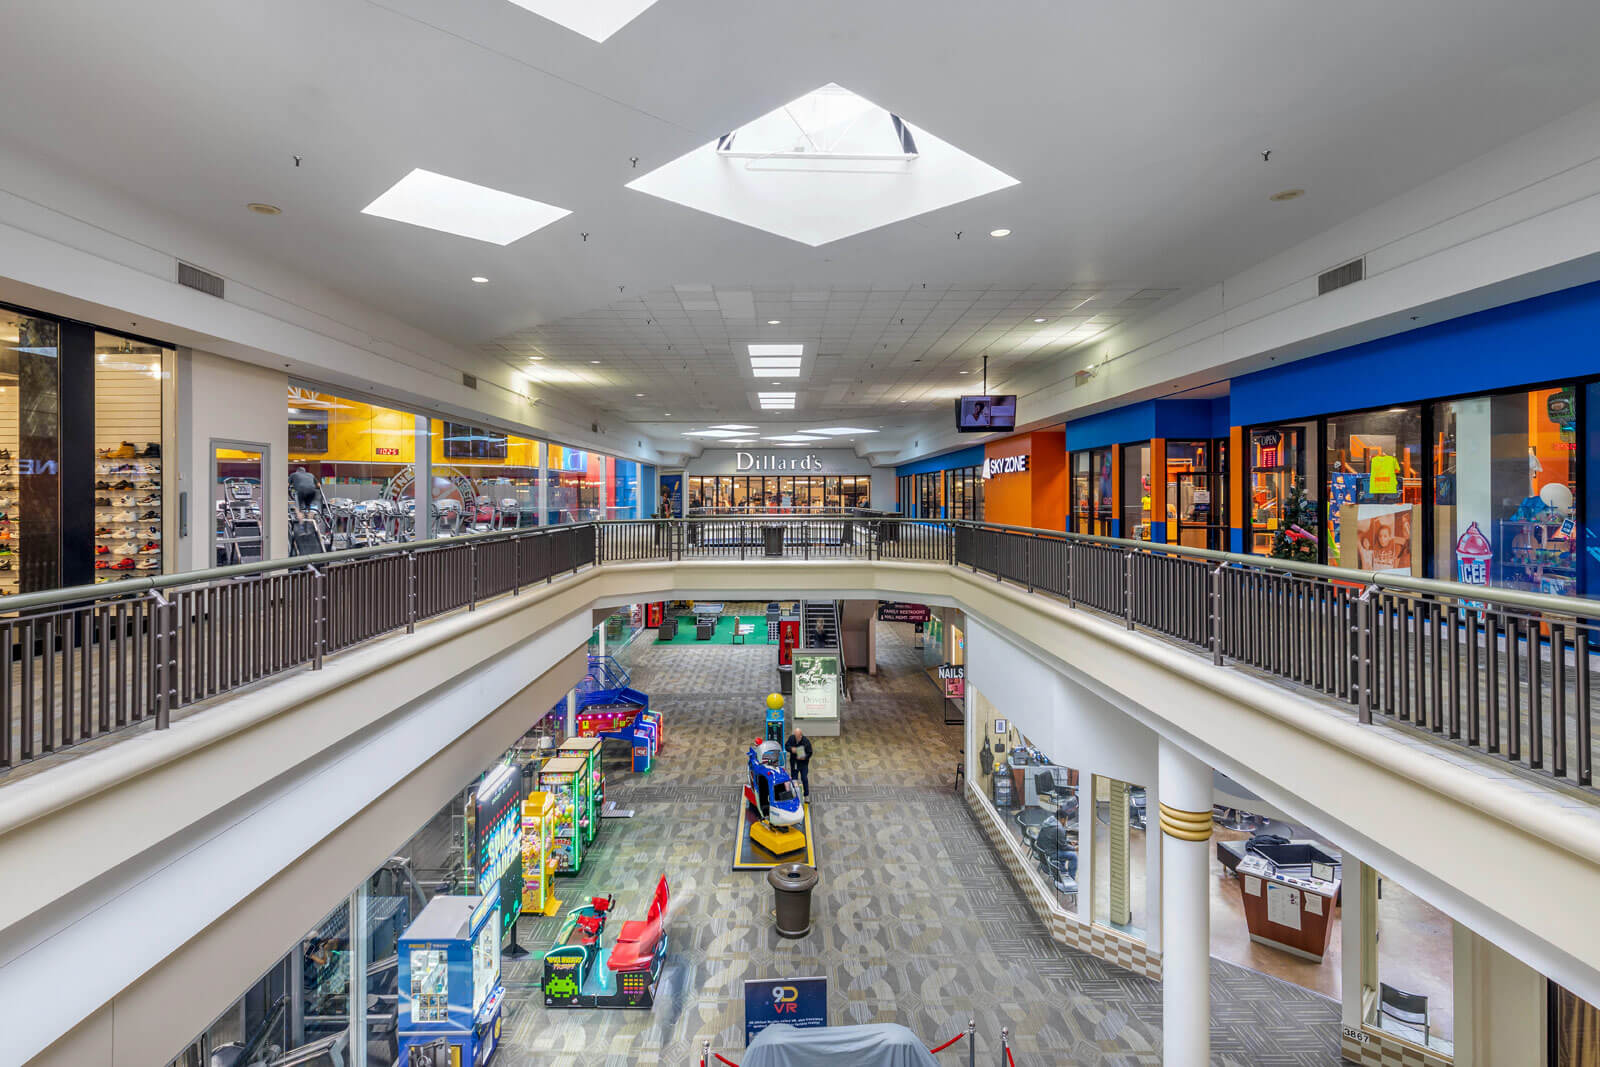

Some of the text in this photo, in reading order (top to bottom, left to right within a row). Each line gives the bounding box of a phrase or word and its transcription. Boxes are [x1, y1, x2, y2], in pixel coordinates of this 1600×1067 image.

[736, 451, 823, 471] Dillard's
[990, 454, 1028, 475] SKY ZONE
[1461, 562, 1487, 585] ICEE
[938, 667, 964, 679] NAILS
[487, 807, 518, 867] SPACE
[772, 986, 798, 1003] 9D
[773, 1002, 798, 1014] VR
[1343, 1028, 1370, 1043] 3867
